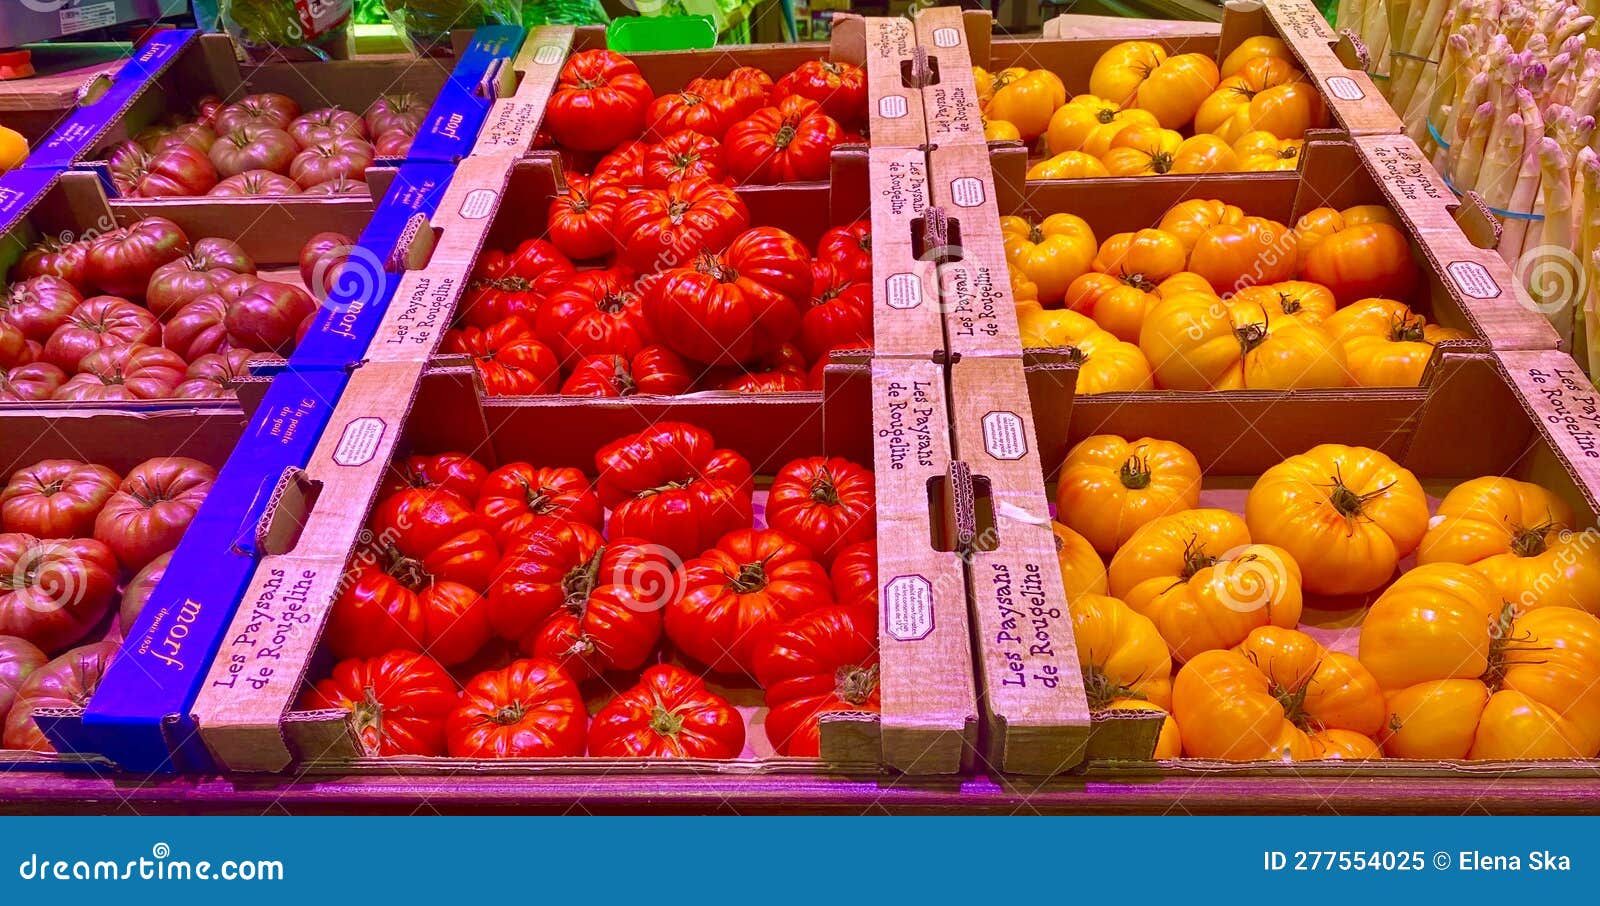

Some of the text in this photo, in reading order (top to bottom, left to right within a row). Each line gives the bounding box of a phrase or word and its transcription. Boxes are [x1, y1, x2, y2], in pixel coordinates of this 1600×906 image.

[439, 113, 464, 141] morf
[883, 161, 907, 215] de Rougeline
[906, 162, 924, 216] Les Paysans
[1375, 147, 1417, 200] de Rougeline
[1394, 146, 1442, 199] Les Paysans
[332, 299, 364, 340] morf
[387, 278, 430, 344] Les Paysans
[411, 278, 454, 344] de Rougeline
[955, 268, 977, 337] Les Paysans
[974, 267, 1003, 337] de Rougeline
[1529, 368, 1600, 458] de Rougeline
[1554, 368, 1583, 392] Les
[879, 382, 910, 470] de Rougeline
[908, 381, 933, 467] Les Paysans
[138, 636, 152, 655] 1950
[151, 599, 201, 671] morf
[213, 568, 285, 689] Les Paysans
[246, 570, 316, 690] de Rougeline
[992, 563, 1026, 688] Les Paysans
[1020, 563, 1061, 689] de Rougeline
